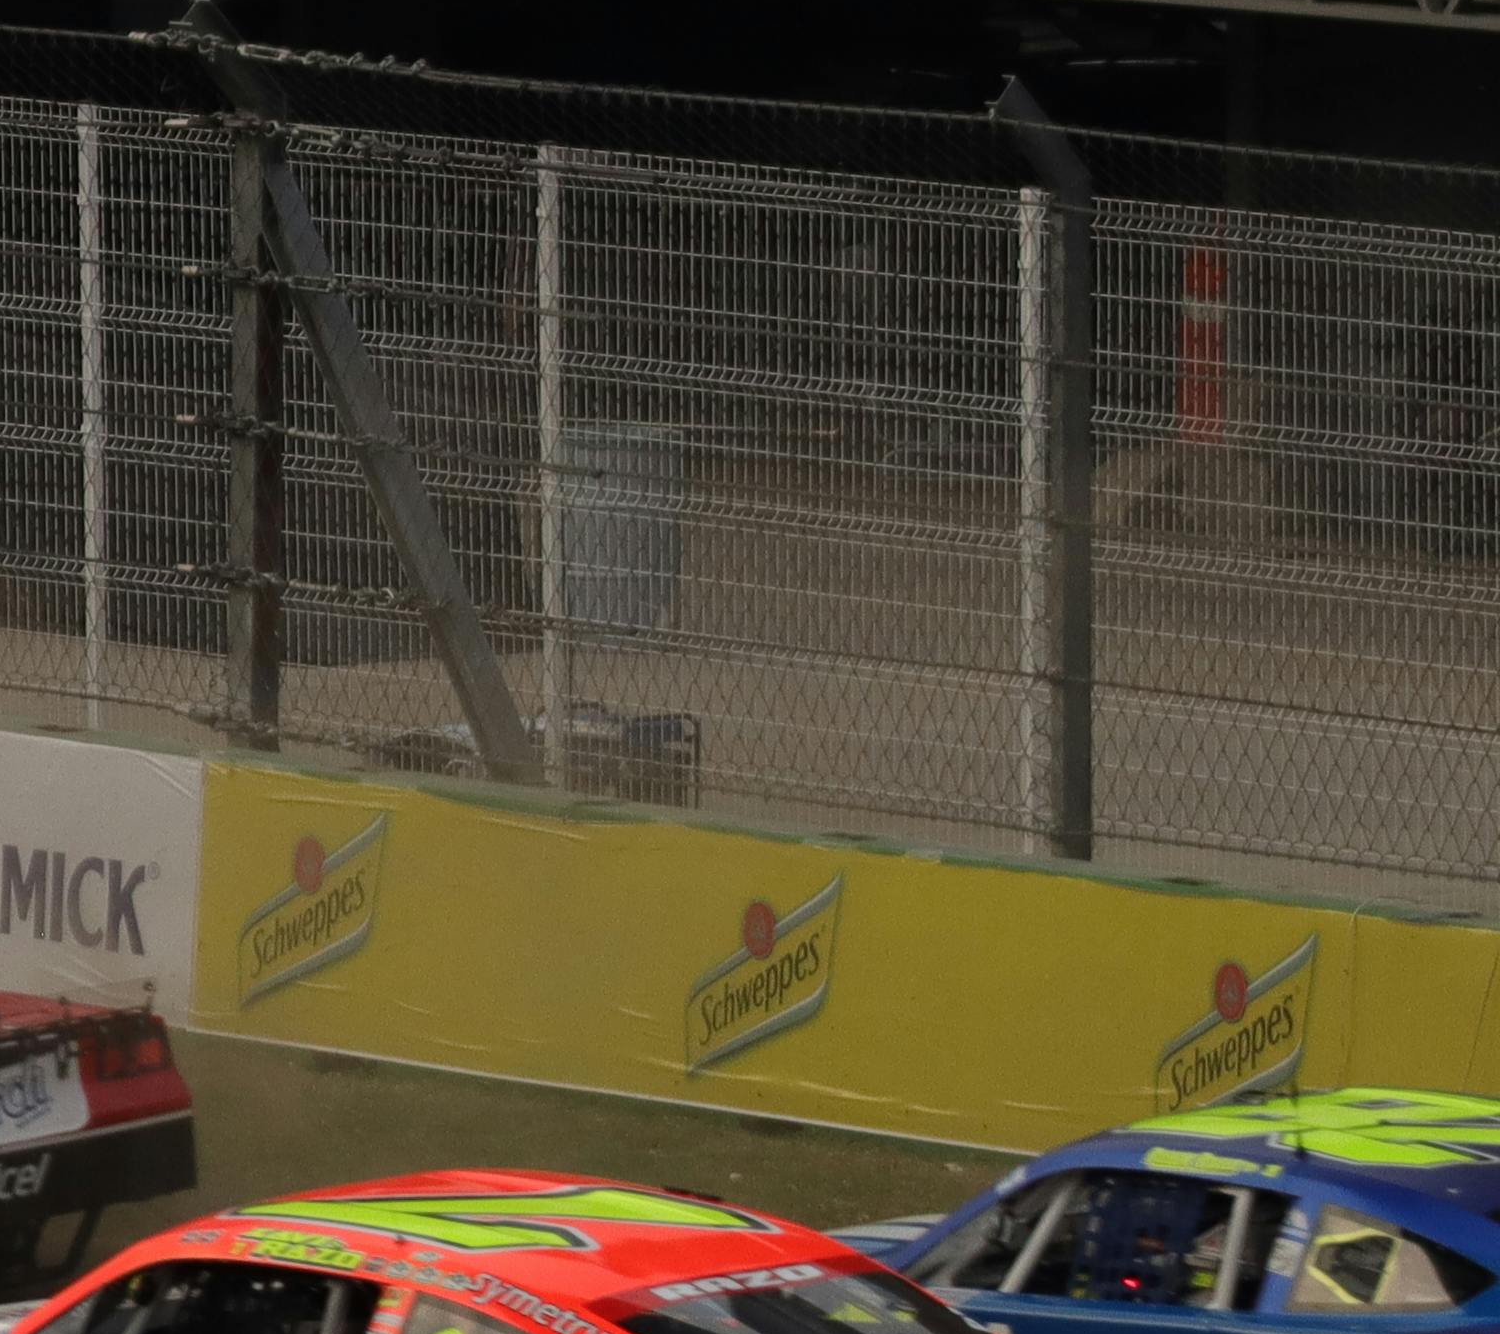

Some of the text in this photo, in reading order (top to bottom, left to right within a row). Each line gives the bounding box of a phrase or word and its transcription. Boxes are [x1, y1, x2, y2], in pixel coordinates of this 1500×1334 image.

[248, 867, 369, 979] Schweppes
[698, 929, 822, 1046] Schweppes
[1169, 992, 1296, 1113] Schweppes
